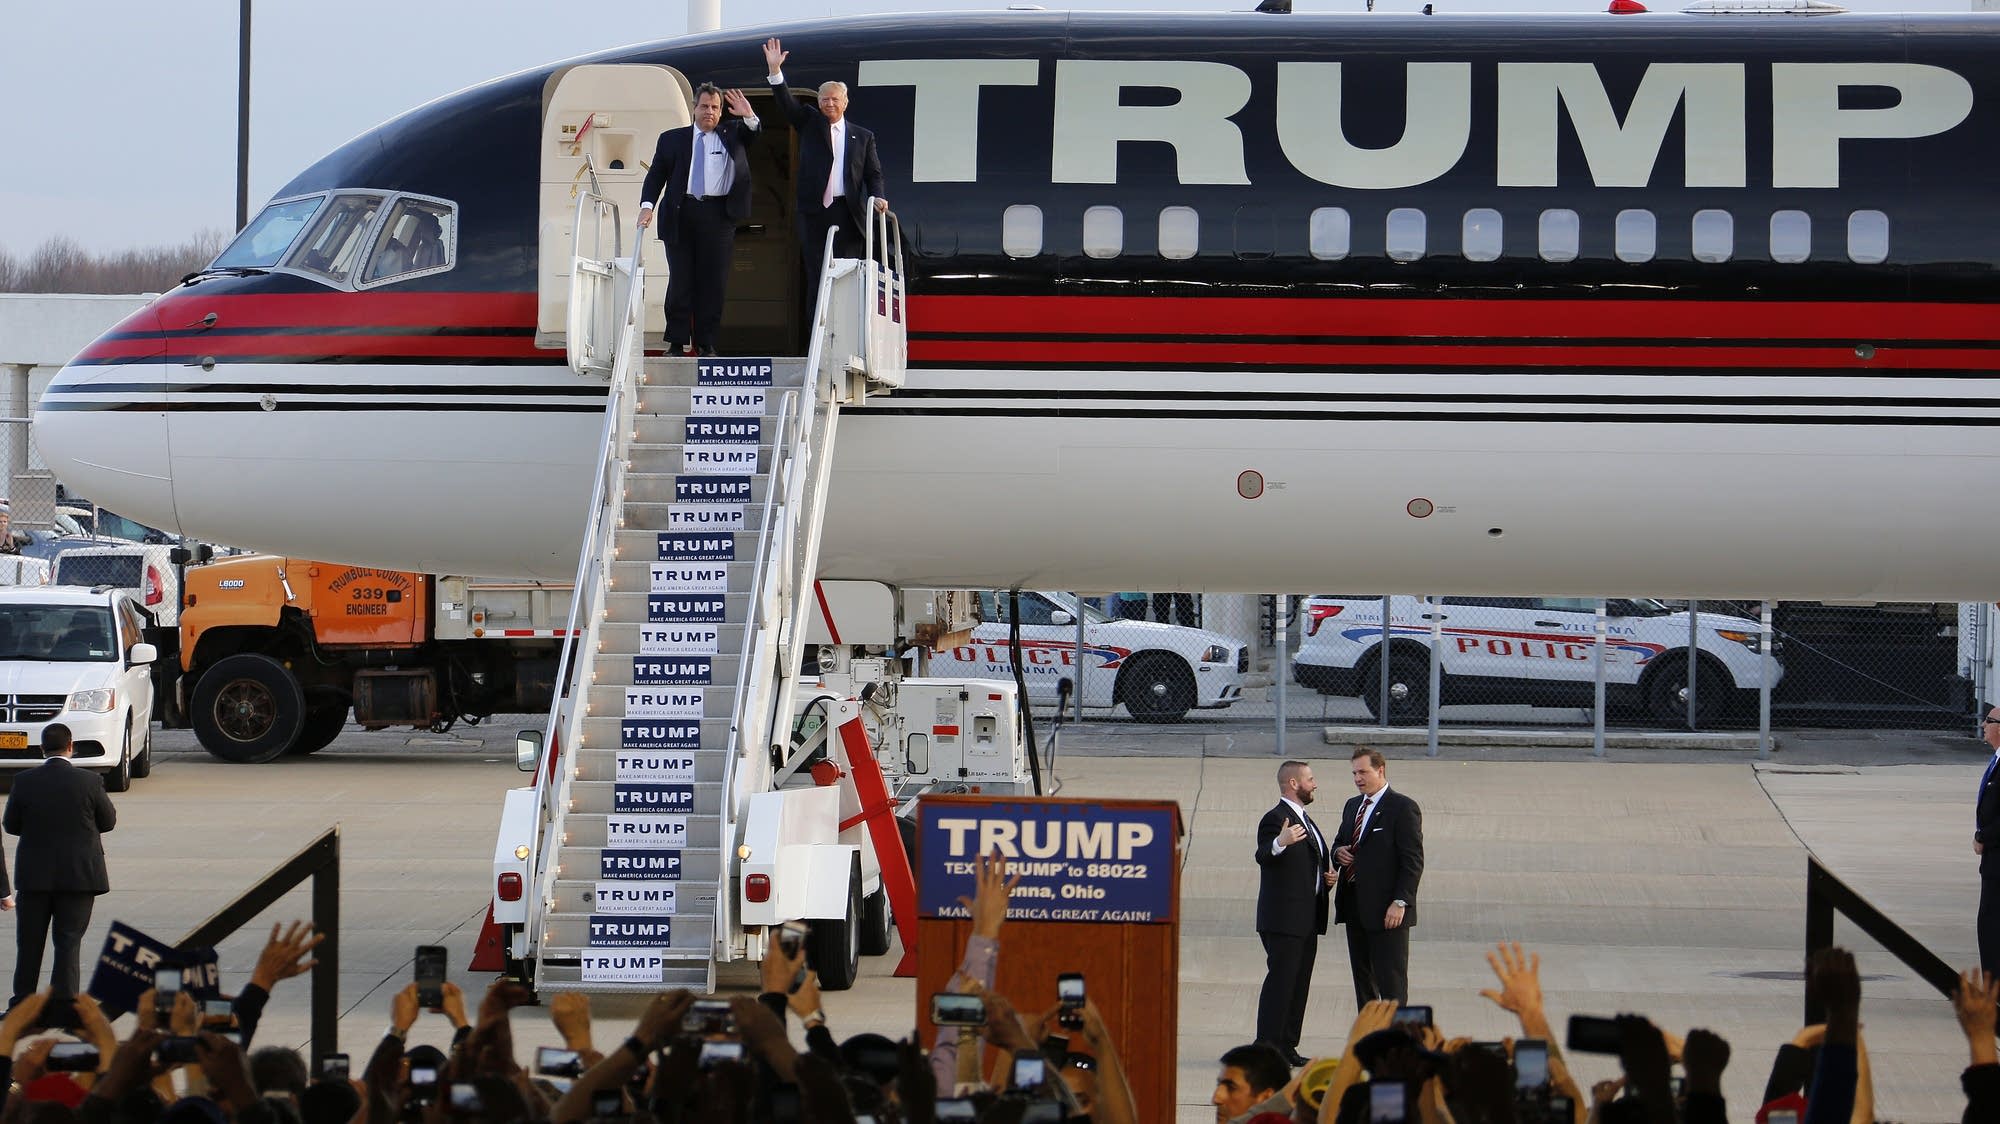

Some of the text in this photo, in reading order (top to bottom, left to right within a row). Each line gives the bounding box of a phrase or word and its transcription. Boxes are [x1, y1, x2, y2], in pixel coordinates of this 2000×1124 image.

[858, 59, 1974, 190] TRUMP
[699, 366, 770, 376] TRUMP
[692, 395, 763, 405] TRUMP
[687, 424, 759, 435] TRUMP
[685, 452, 756, 462] TRUMP
[677, 483, 749, 494] TRUMP
[670, 512, 742, 522] TRUMP
[659, 540, 733, 551] TRUMP
[652, 570, 725, 580] TRUMP
[328, 568, 412, 594] TRUMBULL COUNTY
[352, 588, 383, 599] 339
[346, 604, 387, 615] ENGINEER
[650, 601, 724, 612] TRUMP
[1562, 624, 1635, 635] VIENA
[642, 632, 716, 642] TRUMP
[928, 646, 1076, 665] OLCE
[635, 664, 710, 675] TRUMP
[627, 695, 702, 705] TRUMP
[623, 727, 699, 738] TRUMP
[618, 759, 692, 769] TRUMP
[616, 791, 692, 803] TRUMP
[609, 823, 684, 834] TRUMP
[938, 818, 1154, 860] TRUMP
[603, 857, 679, 869] TRUMP
[944, 862, 976, 874] TEX
[1068, 866, 1083, 877] to
[1087, 864, 1147, 878] 88022
[597, 891, 673, 900] TRUMP
[1001, 884, 1105, 900] enna, Ohio
[938, 907, 1151, 920] MAK ERICA GREAT AGAIN!
[591, 924, 669, 935] TRUMP
[112, 931, 218, 988] TRMP
[583, 958, 660, 968] TRUMP
